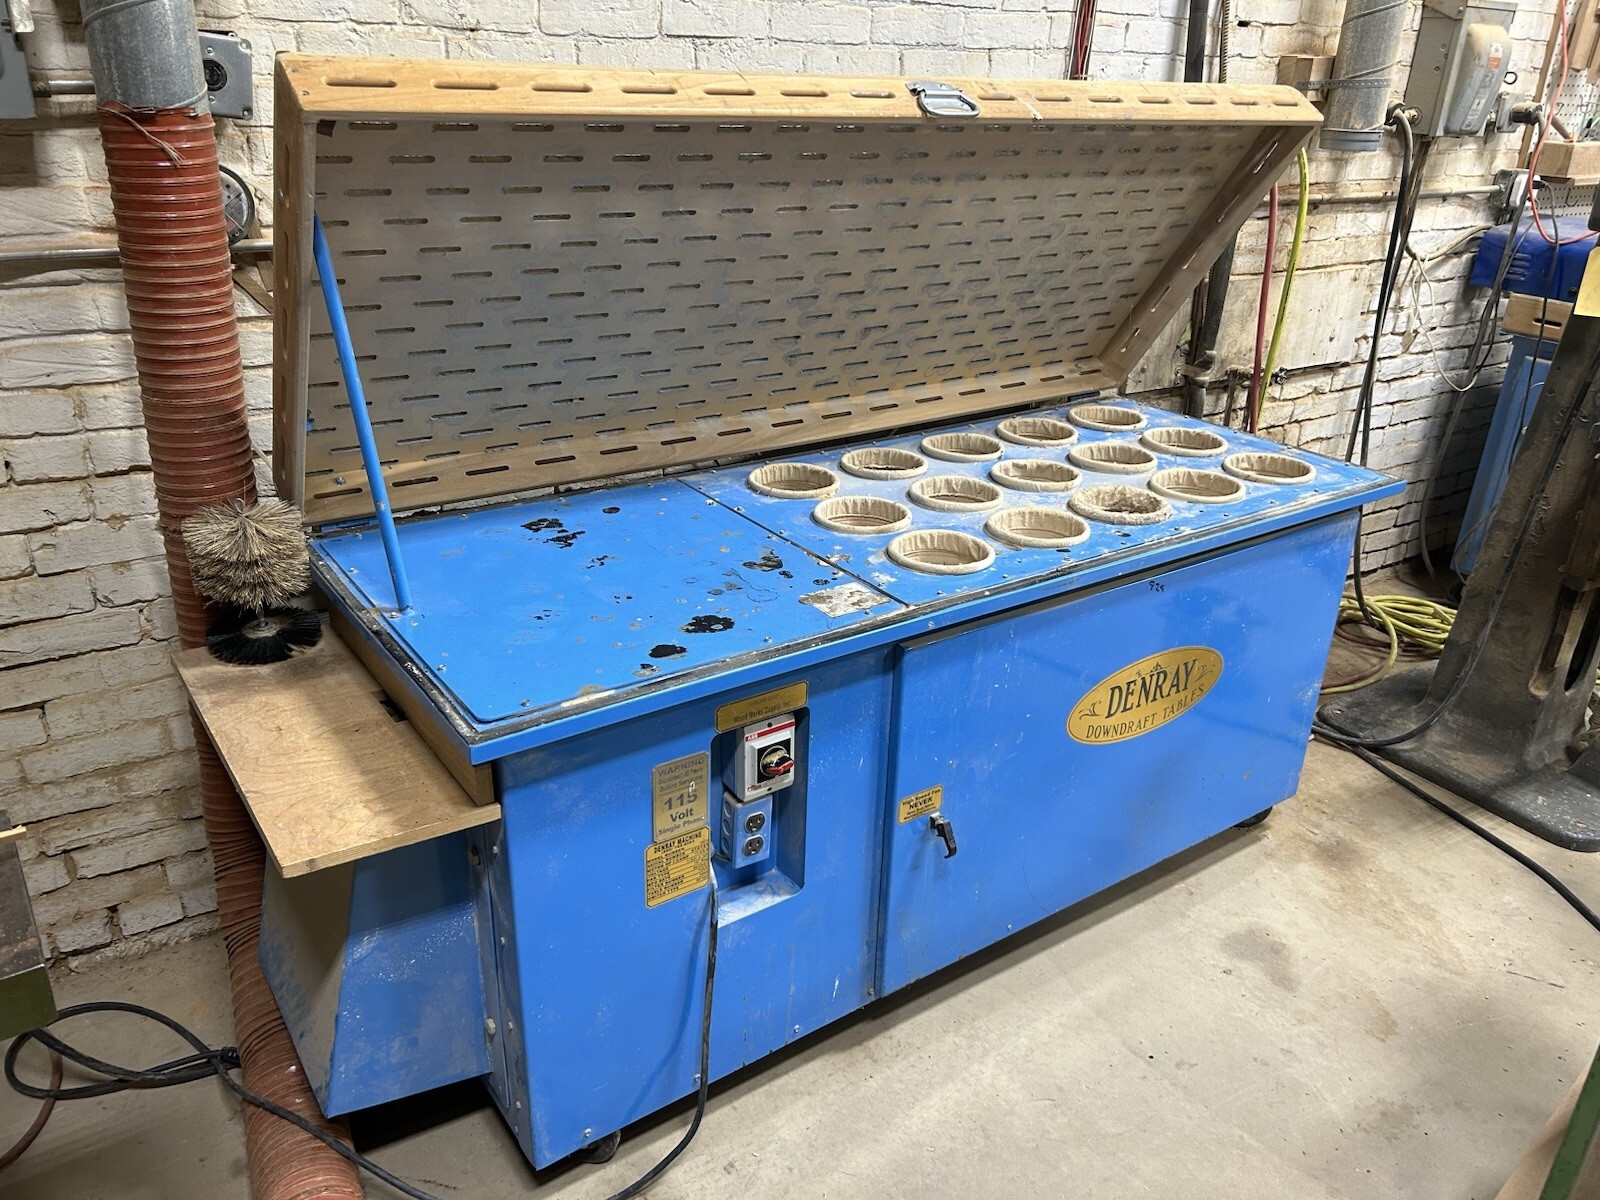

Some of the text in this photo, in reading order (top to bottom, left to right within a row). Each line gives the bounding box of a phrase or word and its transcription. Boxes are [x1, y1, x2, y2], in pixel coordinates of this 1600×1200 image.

[1105, 658, 1198, 719] DENRAY
[1086, 684, 1205, 739] DOWNDRAFT TABLES
[747, 733, 758, 741] ABB
[657, 757, 706, 776] WARNING
[664, 788, 698, 810] 115
[909, 796, 933, 810] NEVER
[669, 807, 694, 822] Volt
[658, 823, 681, 836] Single
[654, 840, 675, 853] DENRAY
[677, 830, 701, 845] MACHINE
